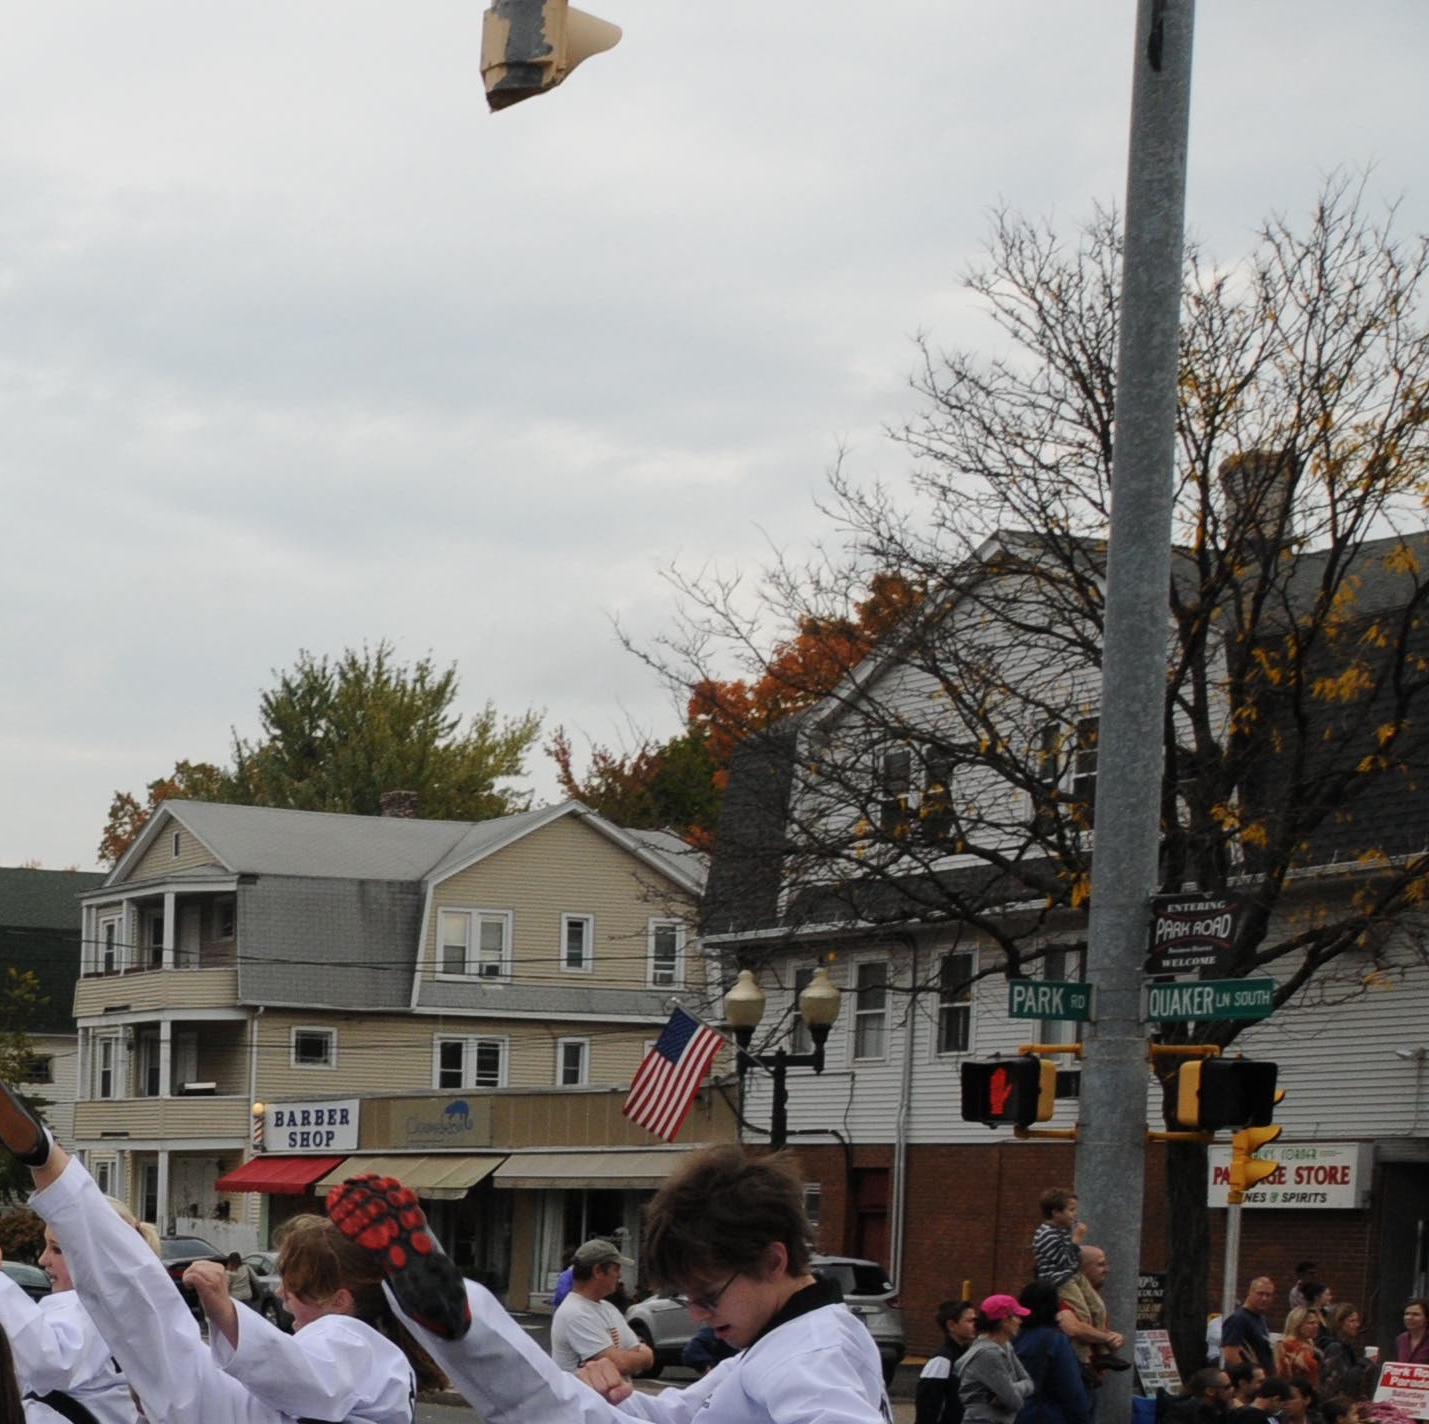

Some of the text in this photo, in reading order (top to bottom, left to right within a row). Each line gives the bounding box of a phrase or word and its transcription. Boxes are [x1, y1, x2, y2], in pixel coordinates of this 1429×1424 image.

[1167, 901, 1226, 912] ENTERING
[1155, 918, 1191, 944] PARK
[1162, 956, 1217, 967] WELCOME
[1012, 985, 1086, 1015] PARK RD
[1149, 987, 1271, 1017] QUAKER LN SOUTH
[274, 1108, 350, 1127] BARBER
[288, 1131, 335, 1148] SHOP
[1213, 1165, 1350, 1185] PAGE STORE
[1242, 1192, 1267, 1203] NES
[1281, 1192, 1327, 1203] SPIRITS
[1139, 1276, 1159, 1288] 0%
